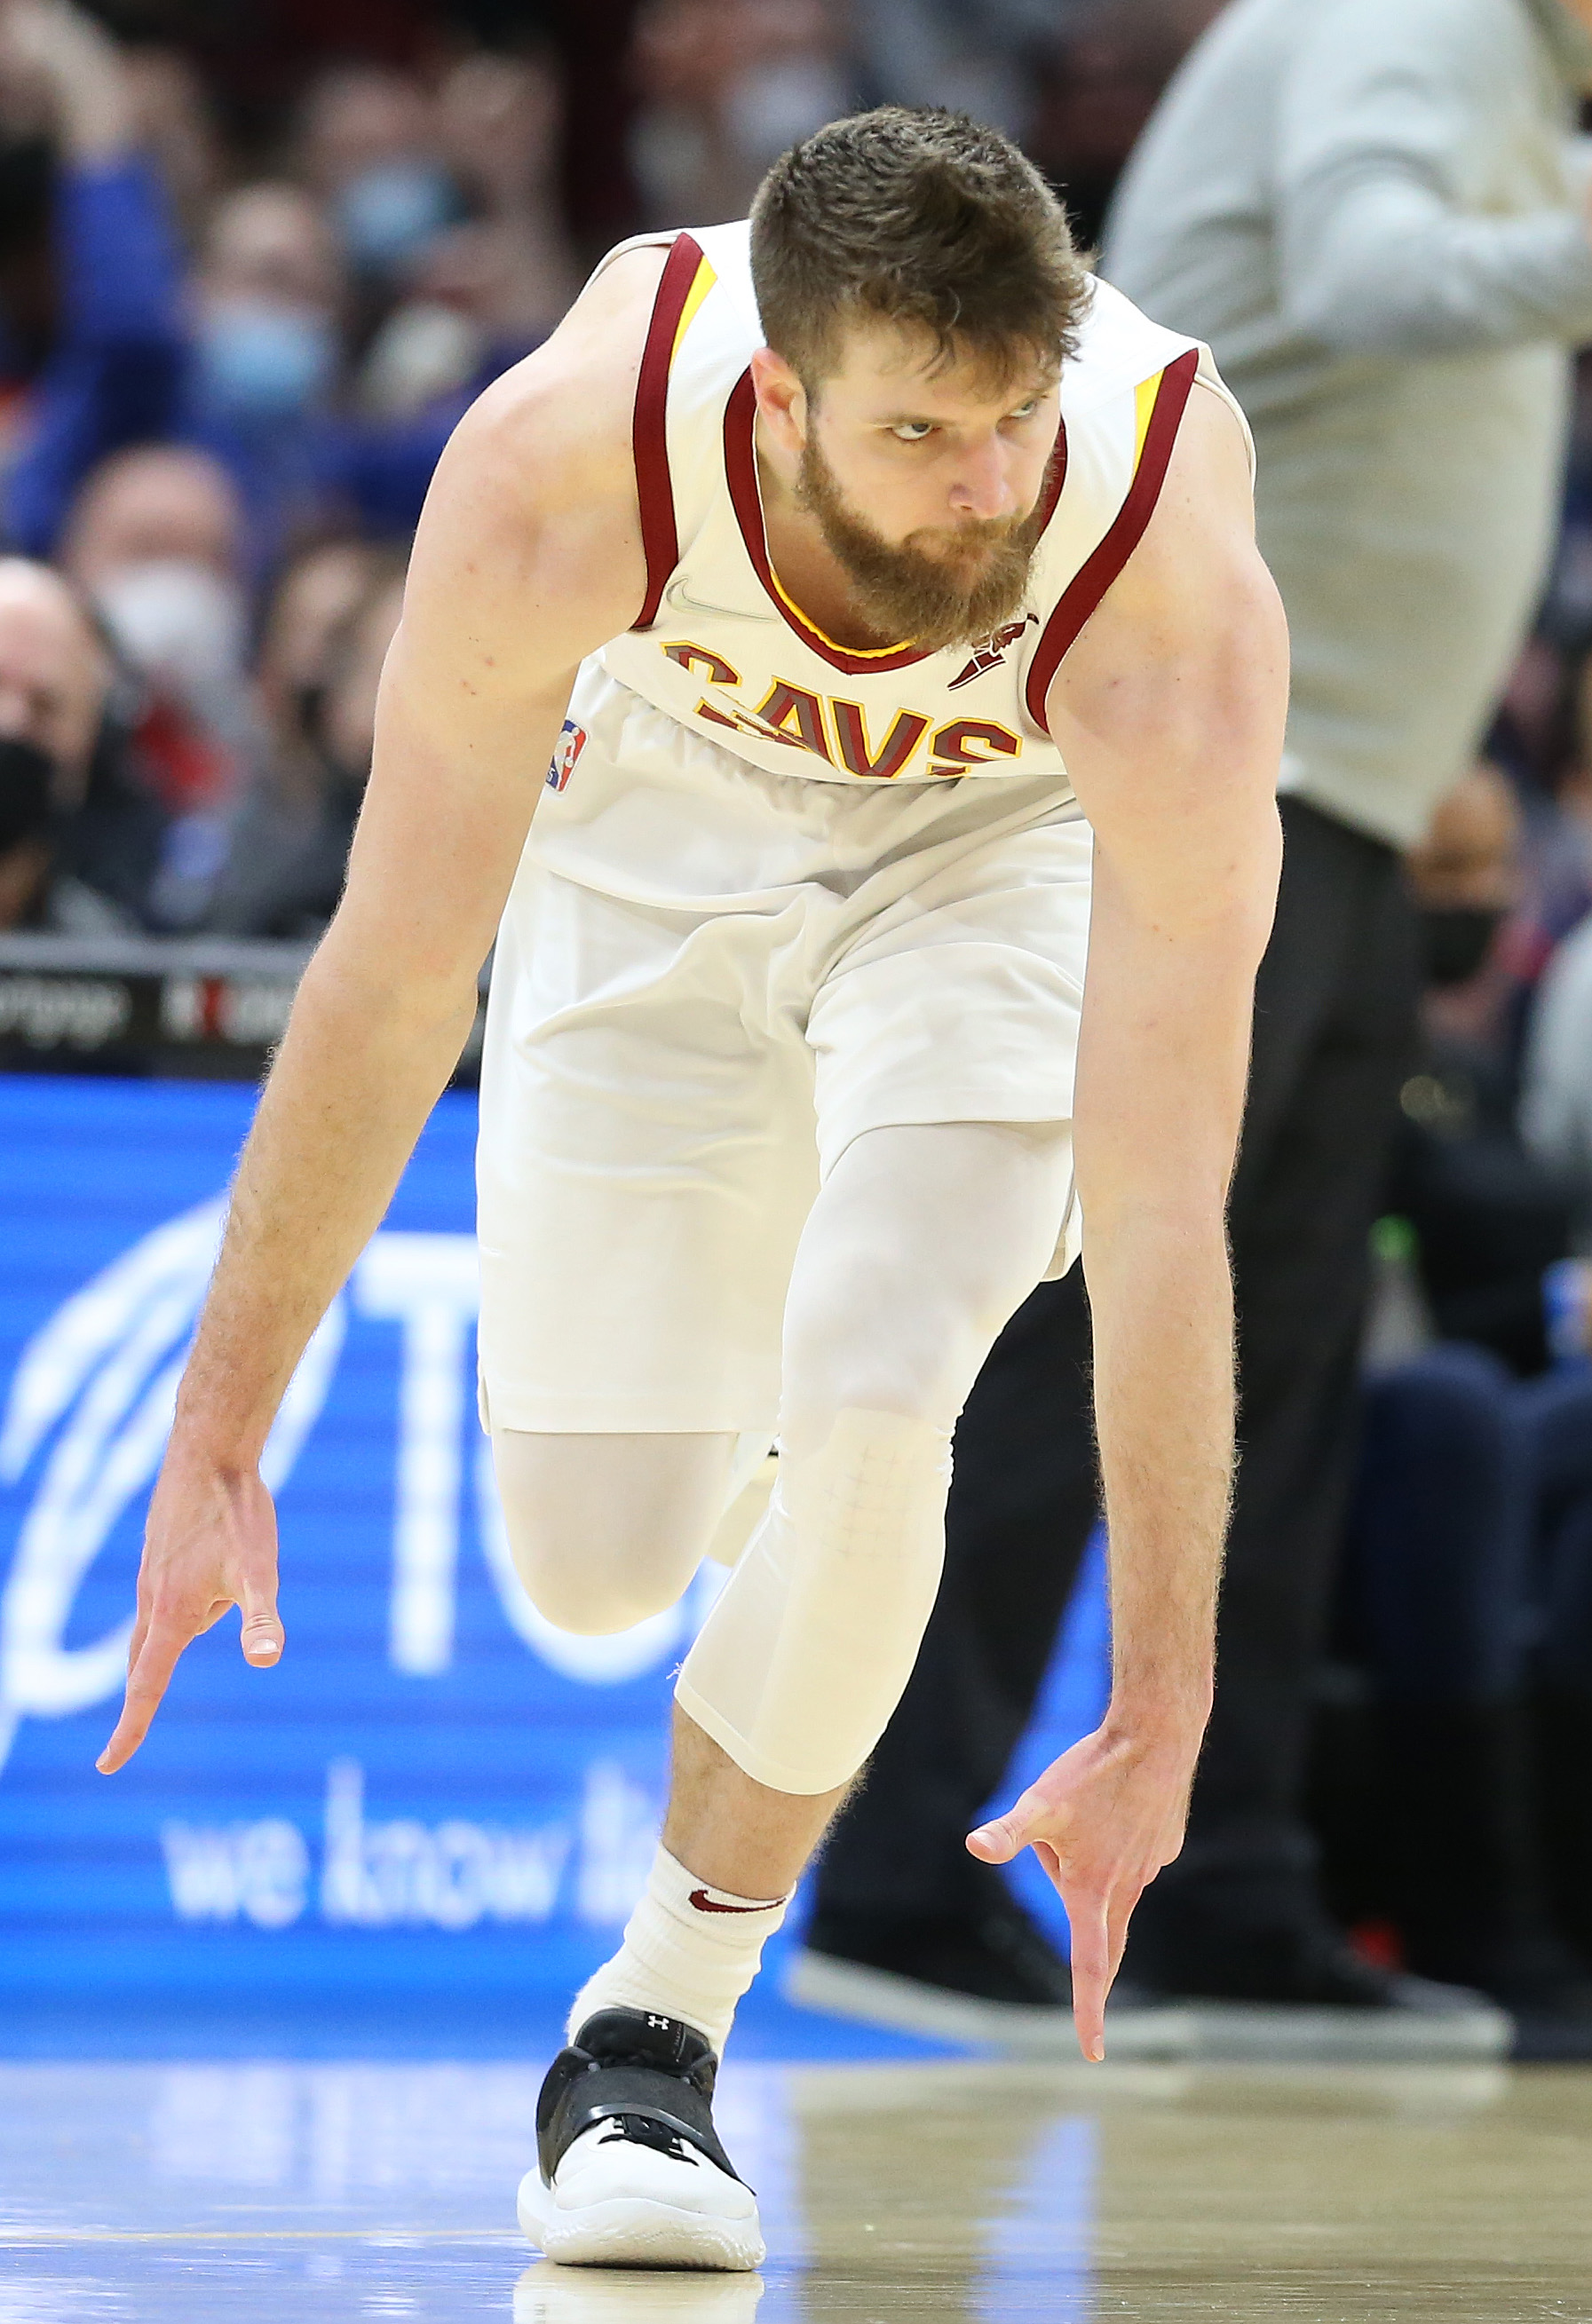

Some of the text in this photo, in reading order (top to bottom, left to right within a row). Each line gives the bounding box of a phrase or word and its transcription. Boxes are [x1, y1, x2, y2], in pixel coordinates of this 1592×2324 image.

[660, 639, 1023, 779] CAVS
[163, 1818, 308, 1928] we
[322, 1758, 572, 1929] know
